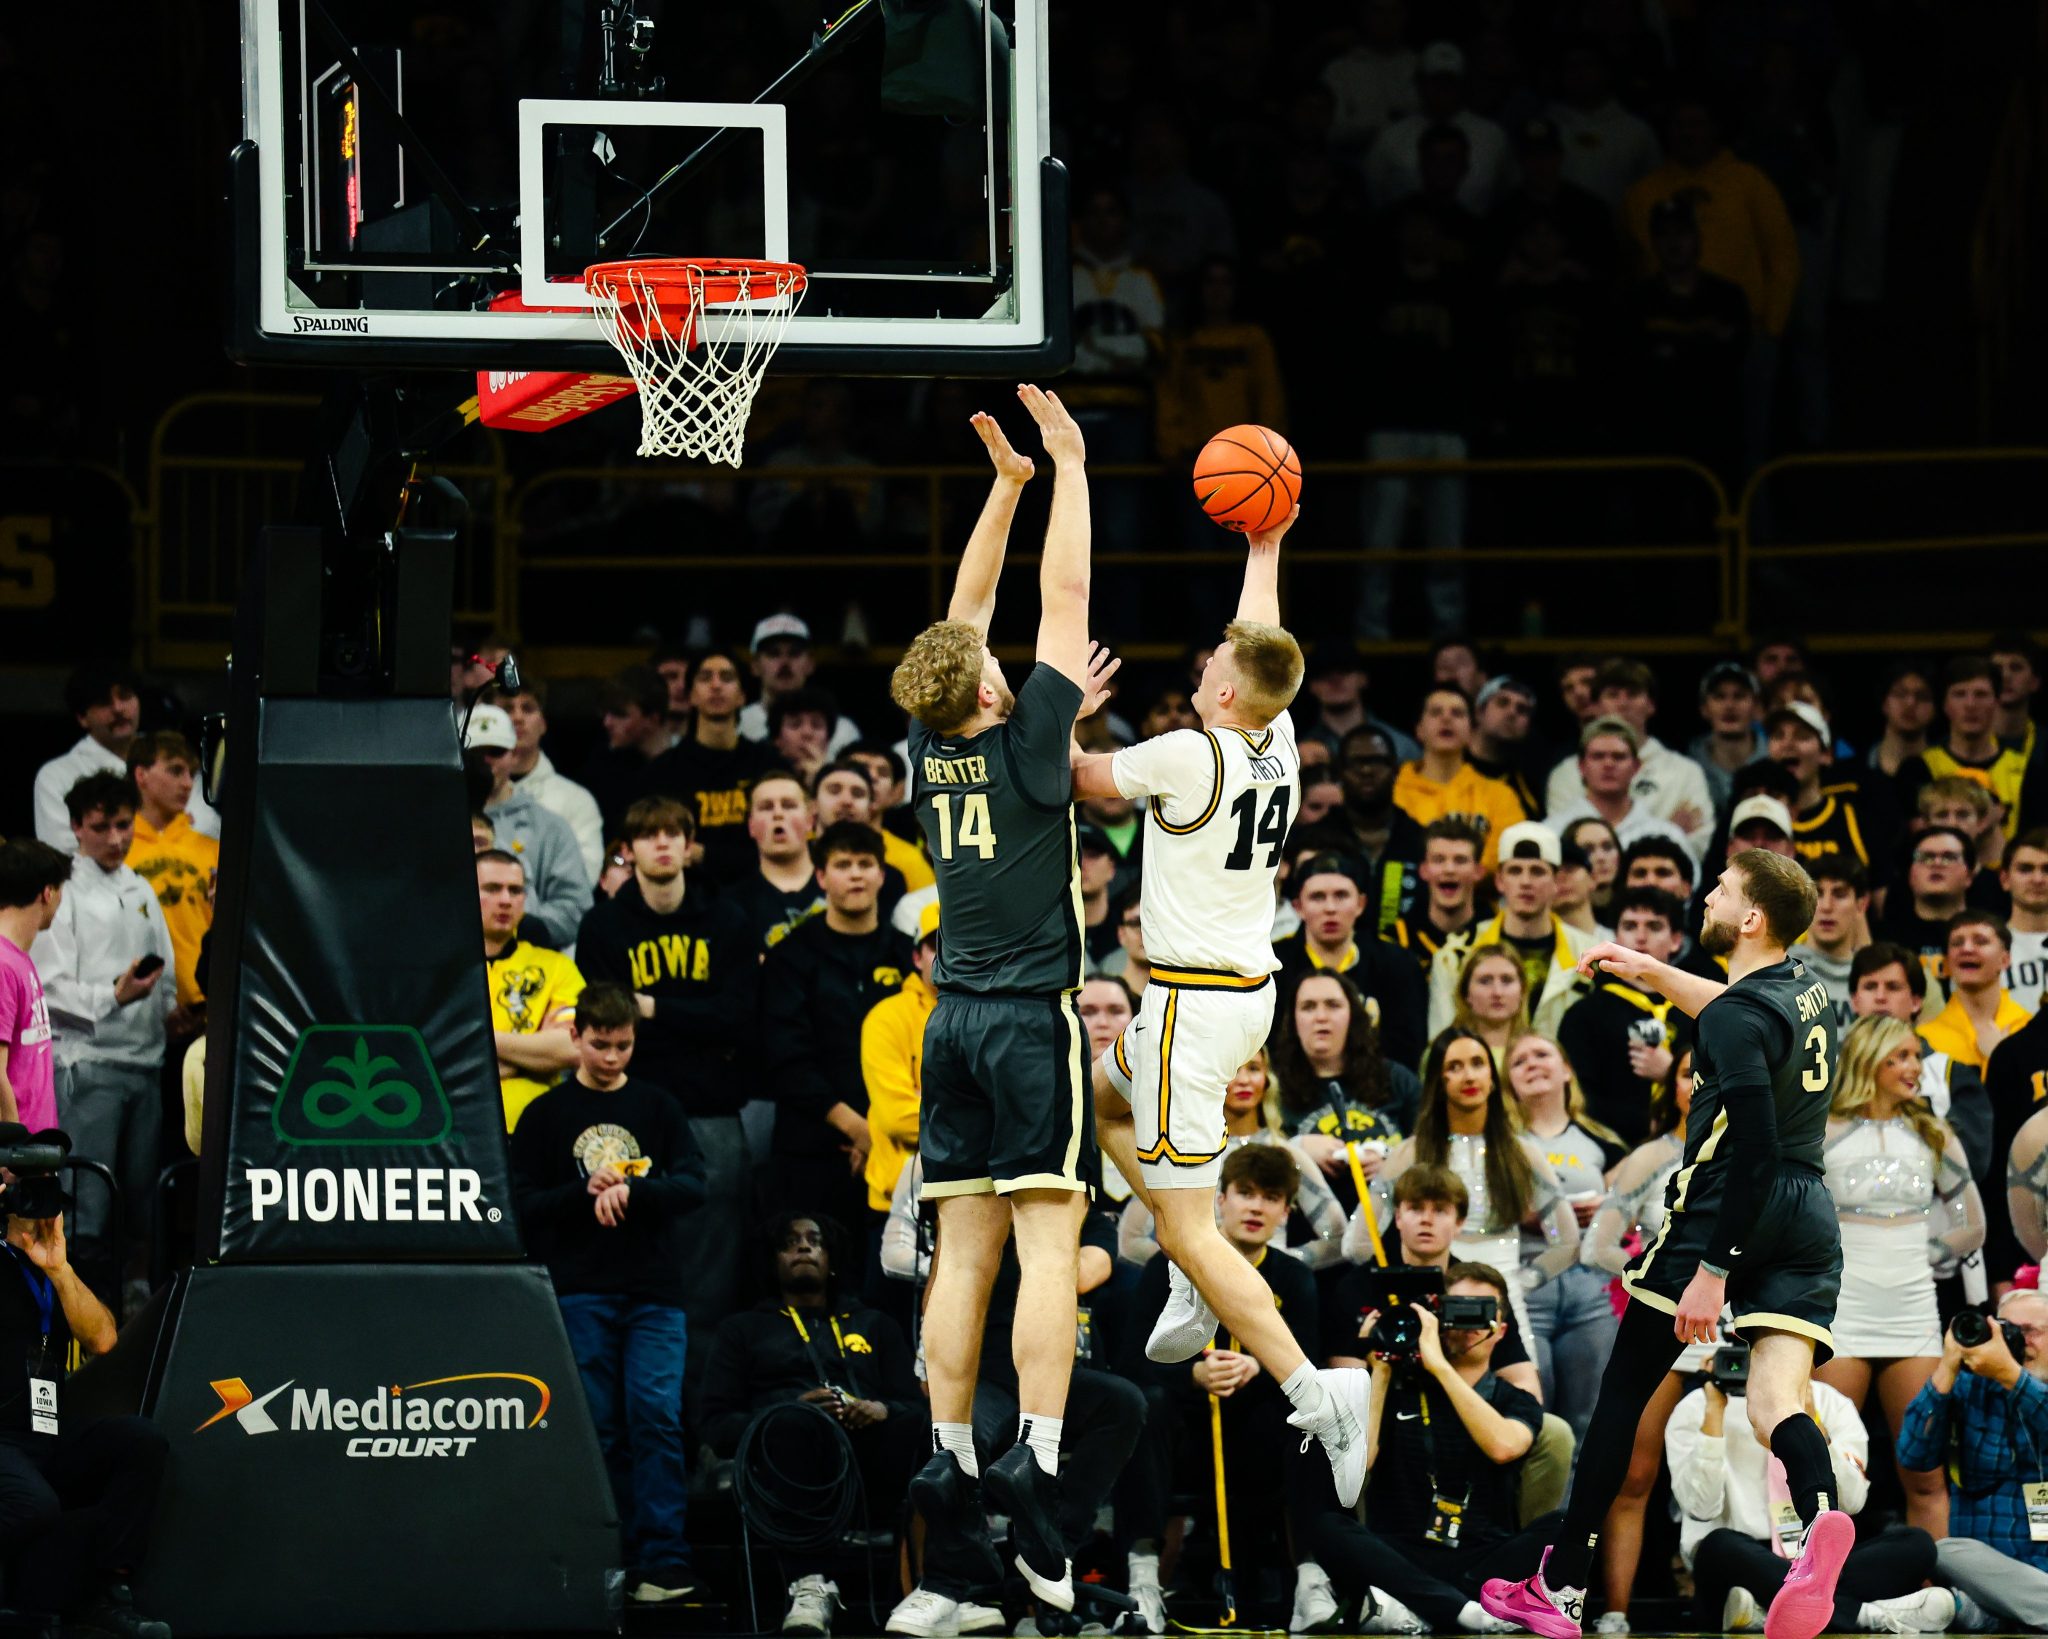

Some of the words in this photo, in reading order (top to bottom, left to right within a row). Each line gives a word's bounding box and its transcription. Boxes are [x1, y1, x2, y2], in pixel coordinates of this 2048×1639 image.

[293, 315, 369, 333] SPALDING
[924, 755, 989, 784] BENTER
[931, 793, 997, 860] 14
[1224, 785, 1291, 870] 14
[628, 934, 710, 990] IOWA
[1795, 981, 1828, 1023] SMITH
[1802, 1024, 1829, 1093] 3
[246, 1168, 483, 1222] PIONEER
[36, 1396, 53, 1408] IOWA
[290, 1385, 525, 1432] Mediacom
[346, 1436, 476, 1458] COURT
